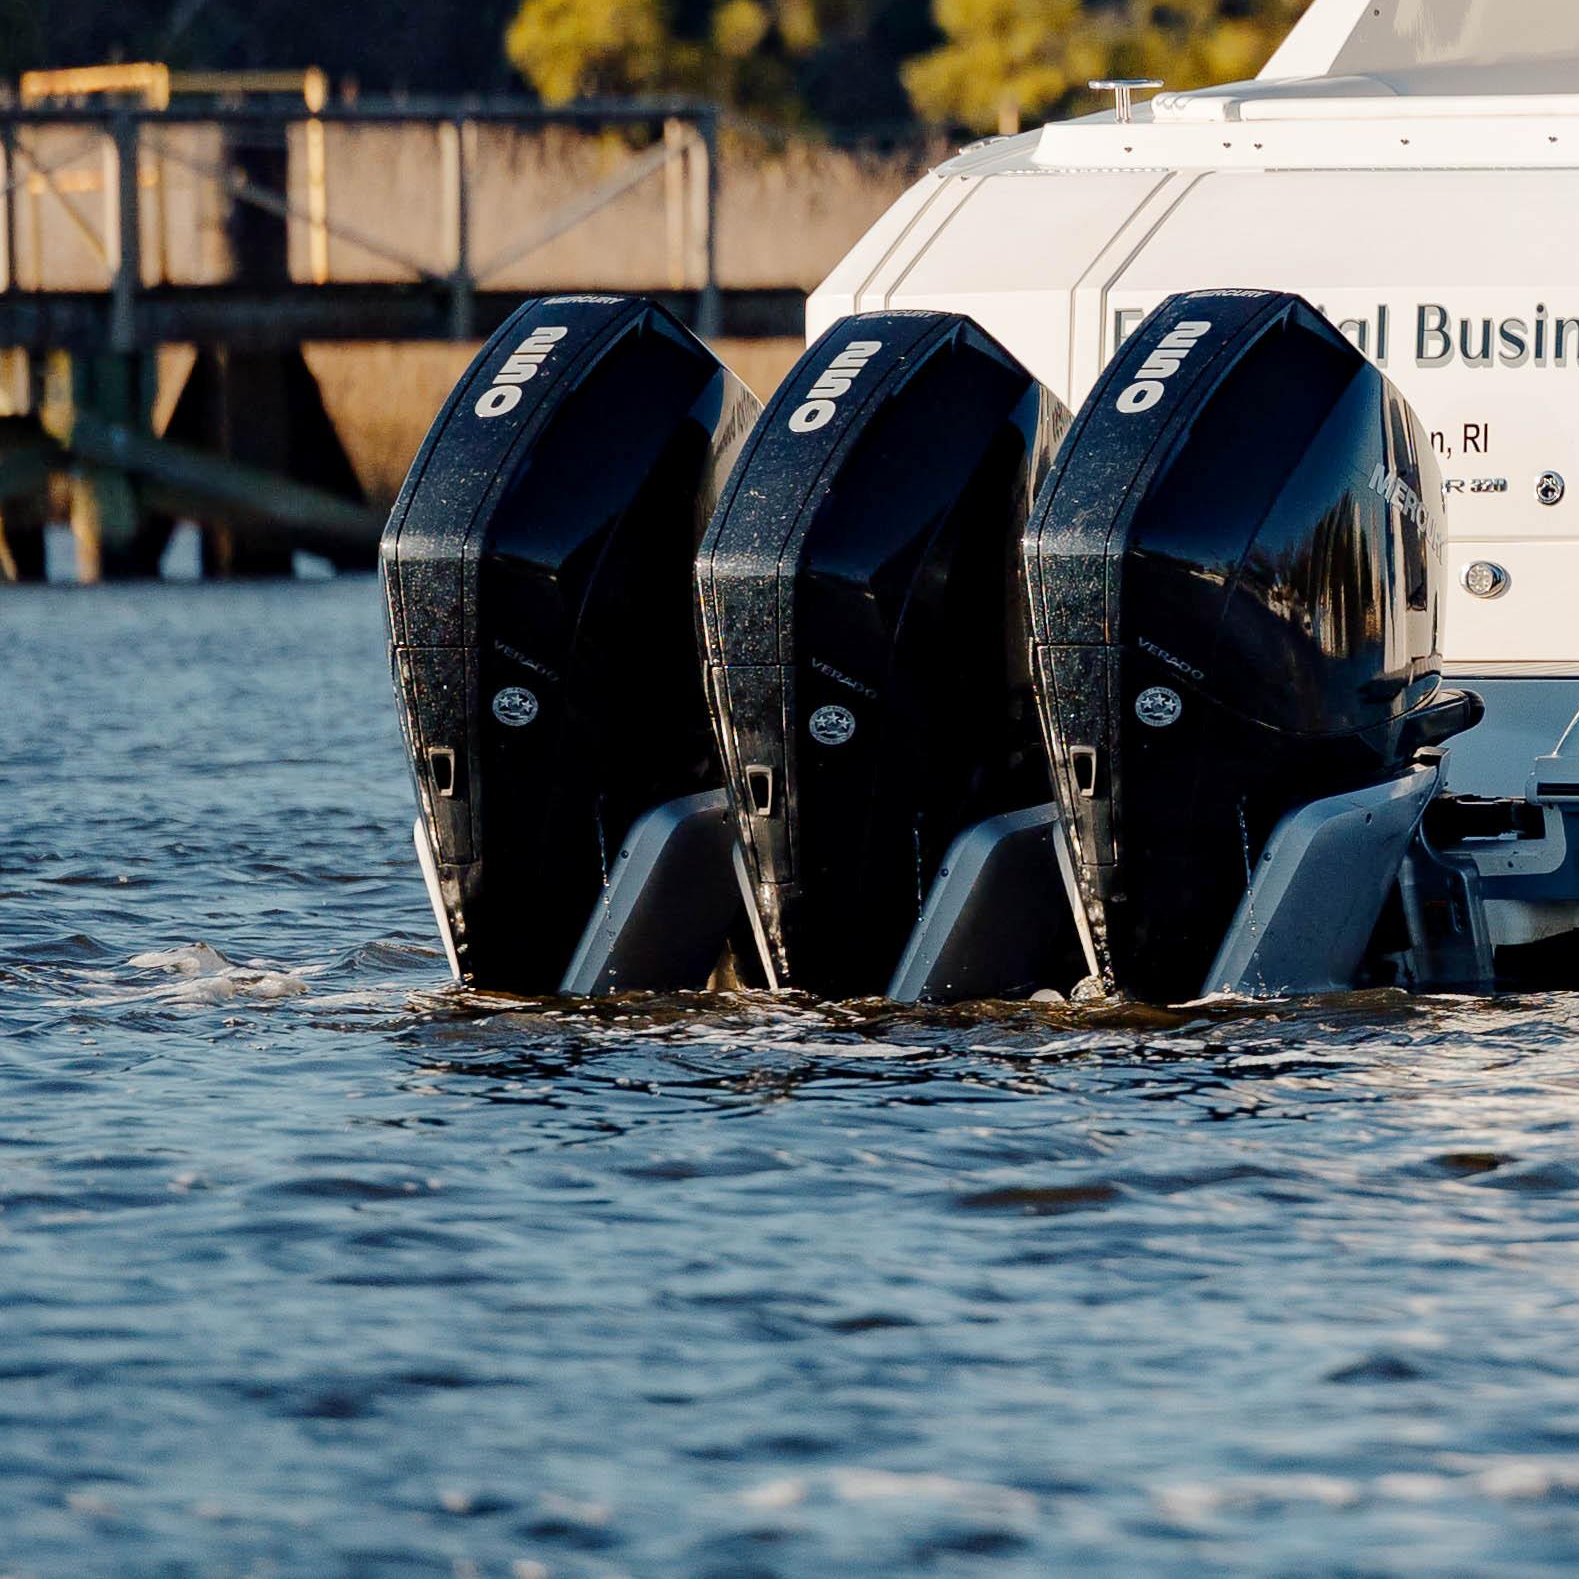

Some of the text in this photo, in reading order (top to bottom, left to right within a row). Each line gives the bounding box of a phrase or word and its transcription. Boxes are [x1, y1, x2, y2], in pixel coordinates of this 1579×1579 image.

[474, 326, 568, 418] 250
[788, 340, 883, 433] 250
[1115, 320, 1212, 414] 250
[1462, 423, 1489, 453] RI
[1137, 635, 1206, 681] VERADO
